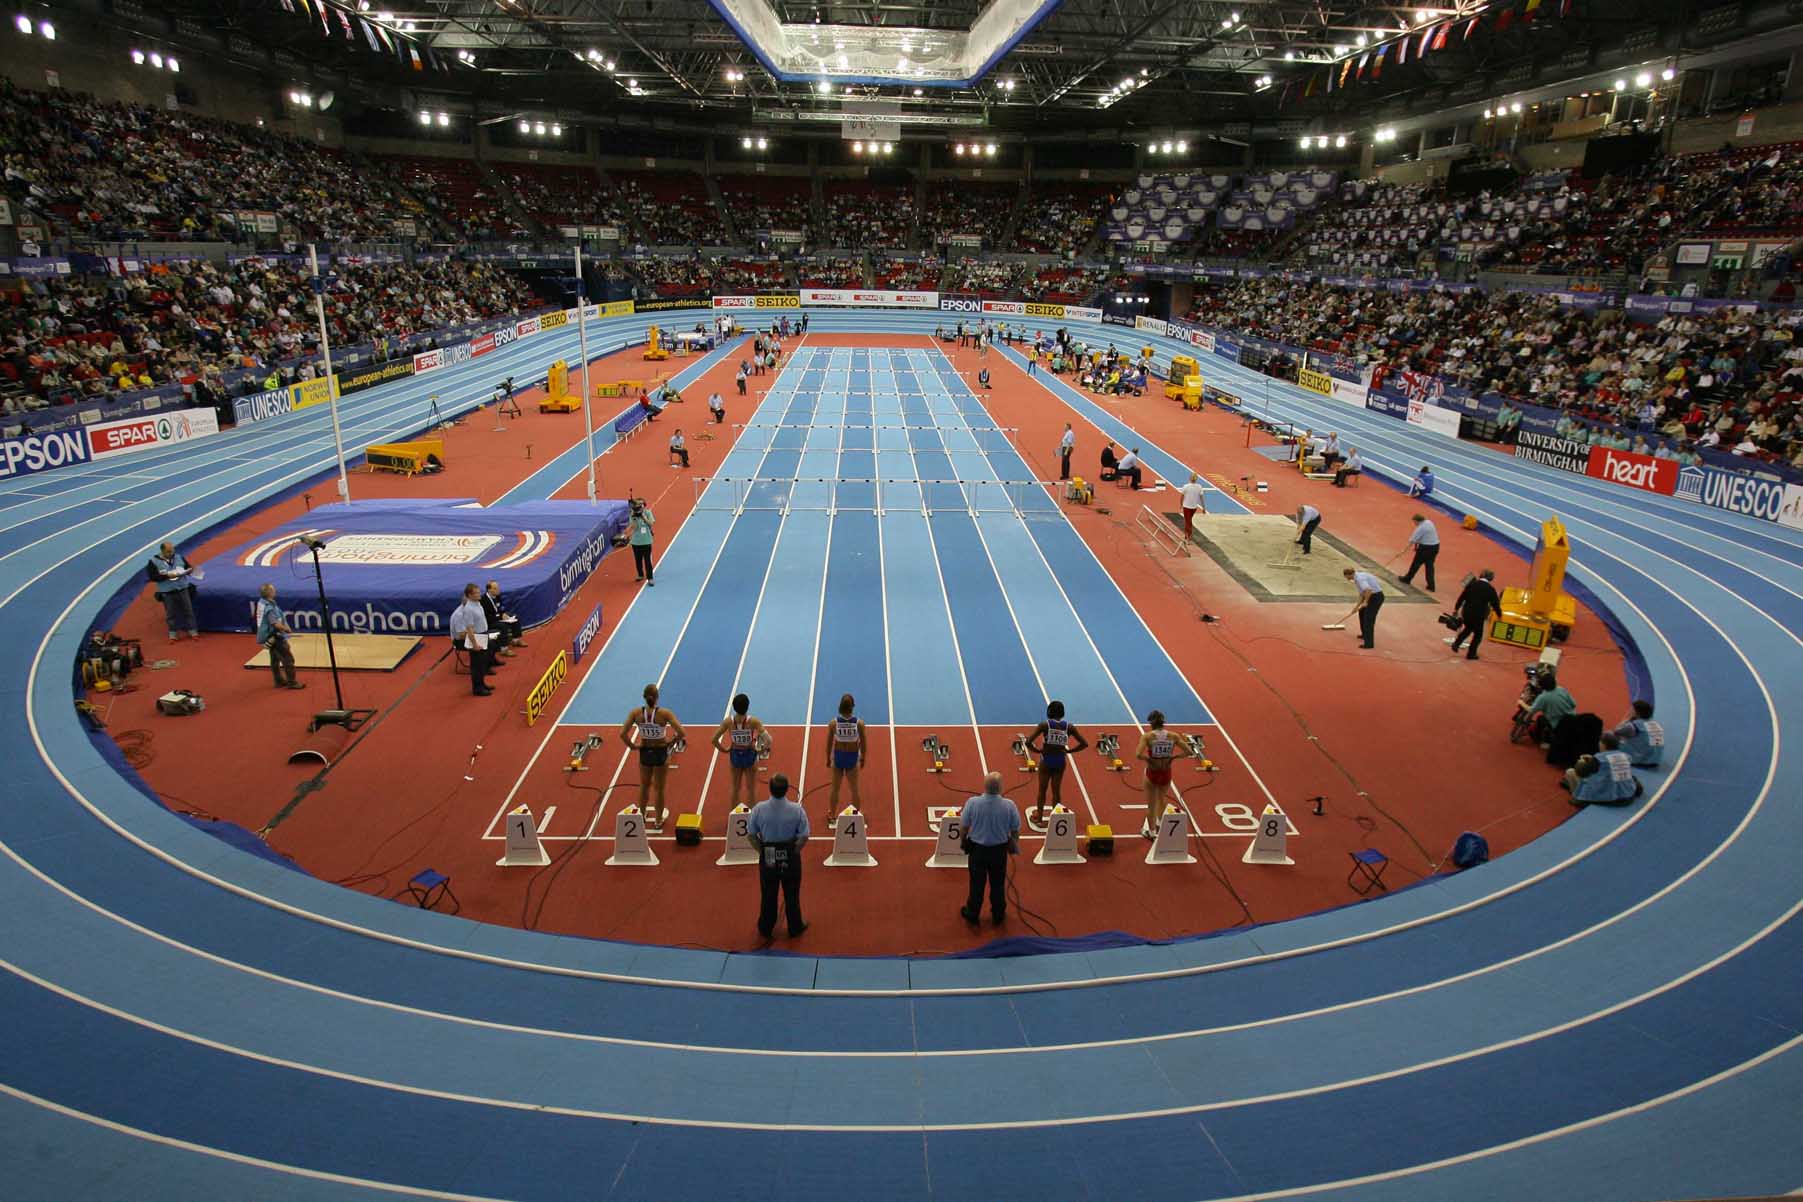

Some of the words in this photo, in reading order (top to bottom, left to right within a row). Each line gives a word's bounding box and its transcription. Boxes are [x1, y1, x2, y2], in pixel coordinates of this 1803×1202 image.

[756, 297, 798, 307] SEIKO
[940, 300, 981, 312] EPSON
[991, 304, 1015, 312] SPAR
[1025, 304, 1065, 317] SEIKO
[521, 321, 536, 334] SPAR
[540, 311, 567, 329] SEIKO
[494, 326, 517, 347] EPSON
[1168, 323, 1192, 341] EPSON
[452, 343, 472, 363] UNESCO
[1300, 372, 1331, 394] SEIKO
[251, 391, 291, 420] UNESCO
[107, 424, 156, 448] SPAR
[1518, 430, 1581, 454] UNIVERSITY
[1515, 445, 1588, 474] BIRMINGHAM
[1603, 451, 1659, 489] heart
[1704, 471, 1784, 520] UNESCO
[560, 532, 606, 592] birmingham
[250, 602, 441, 634] rmngham
[578, 611, 600, 655] EPSON
[530, 656, 565, 719] SEIKO
[1214, 803, 1260, 830] 8
[516, 821, 527, 838] 1
[624, 820, 637, 838] 2
[735, 819, 748, 837] 3
[844, 821, 858, 839] 4
[948, 823, 960, 840] 5
[1055, 819, 1068, 837] 6
[1168, 820, 1180, 837] 7
[1265, 819, 1279, 838] 8
